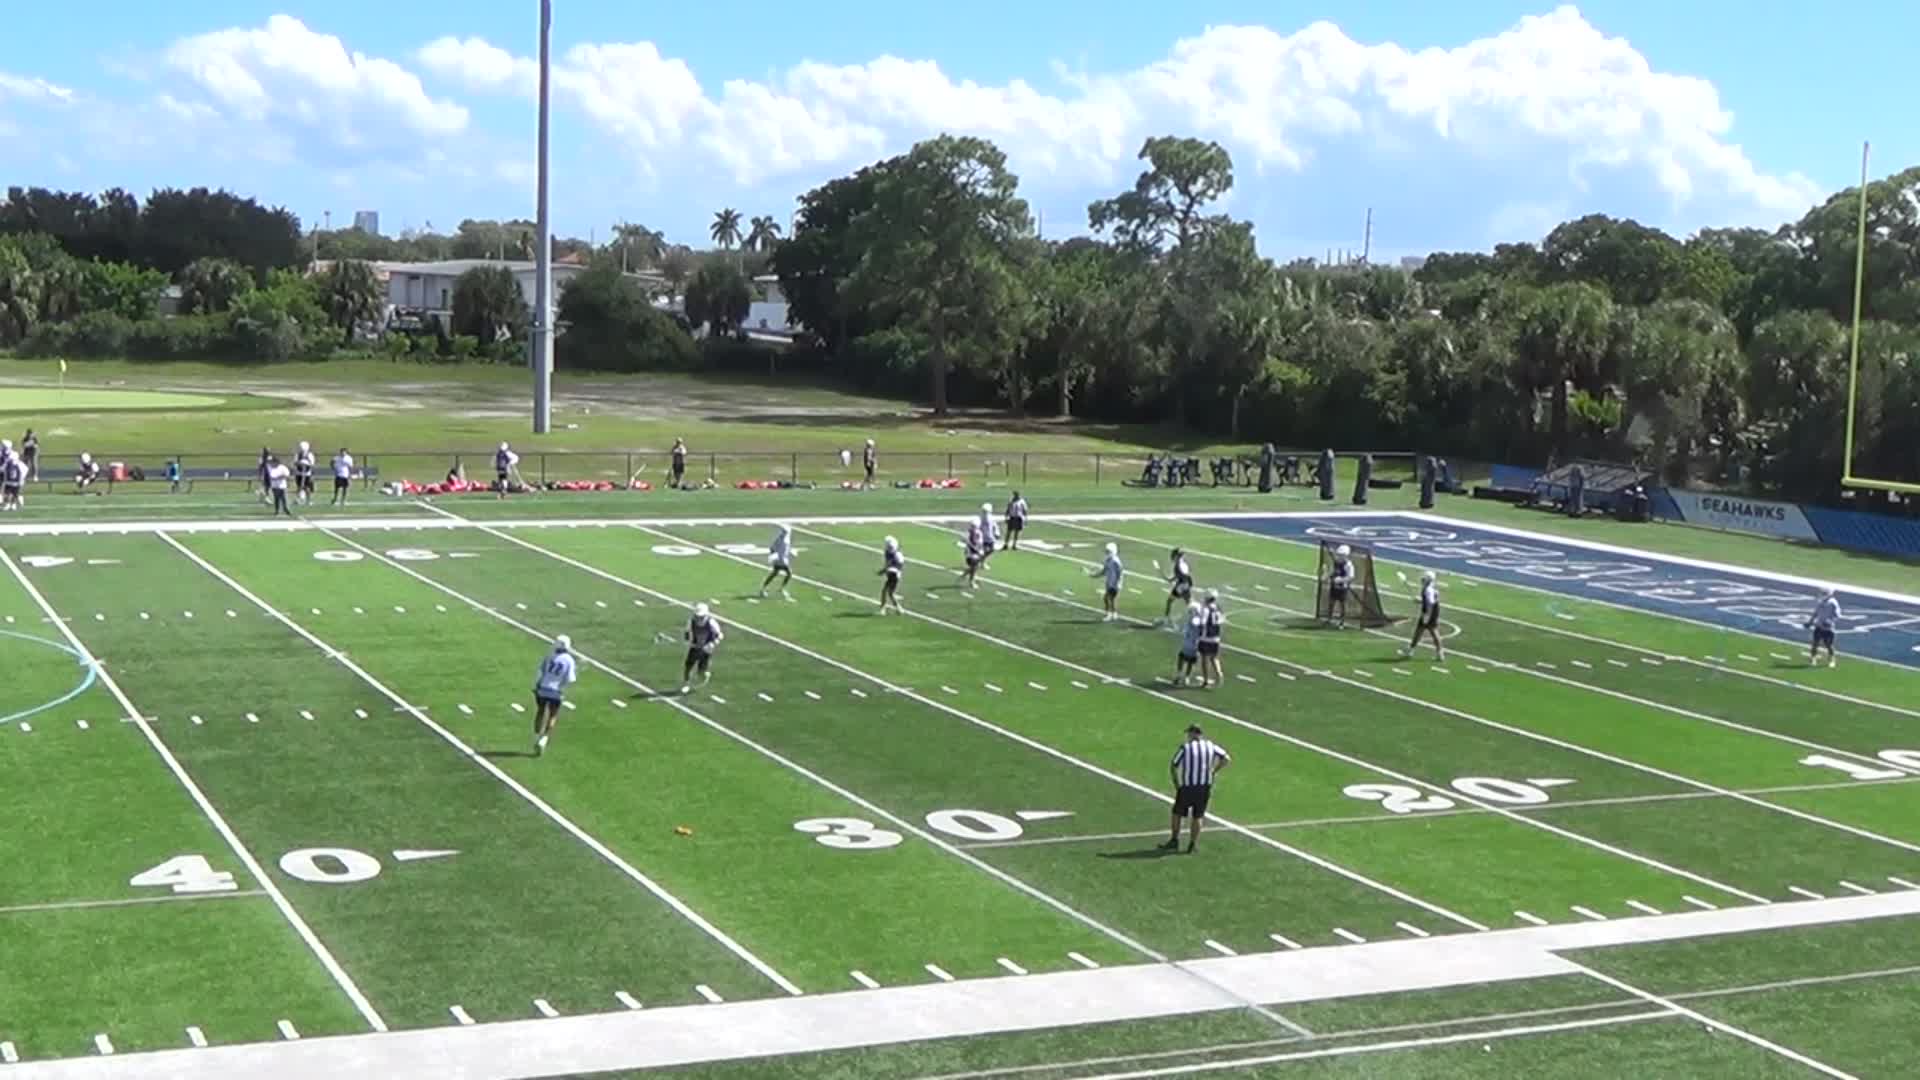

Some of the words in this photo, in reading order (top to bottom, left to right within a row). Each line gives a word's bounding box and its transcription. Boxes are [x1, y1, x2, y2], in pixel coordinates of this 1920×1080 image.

[1701, 496, 1786, 521] SEAHAWKS
[1306, 524, 1920, 650] SEAHA
[1343, 776, 1550, 813] 20
[793, 809, 1024, 849] 30
[129, 847, 382, 893] 40
